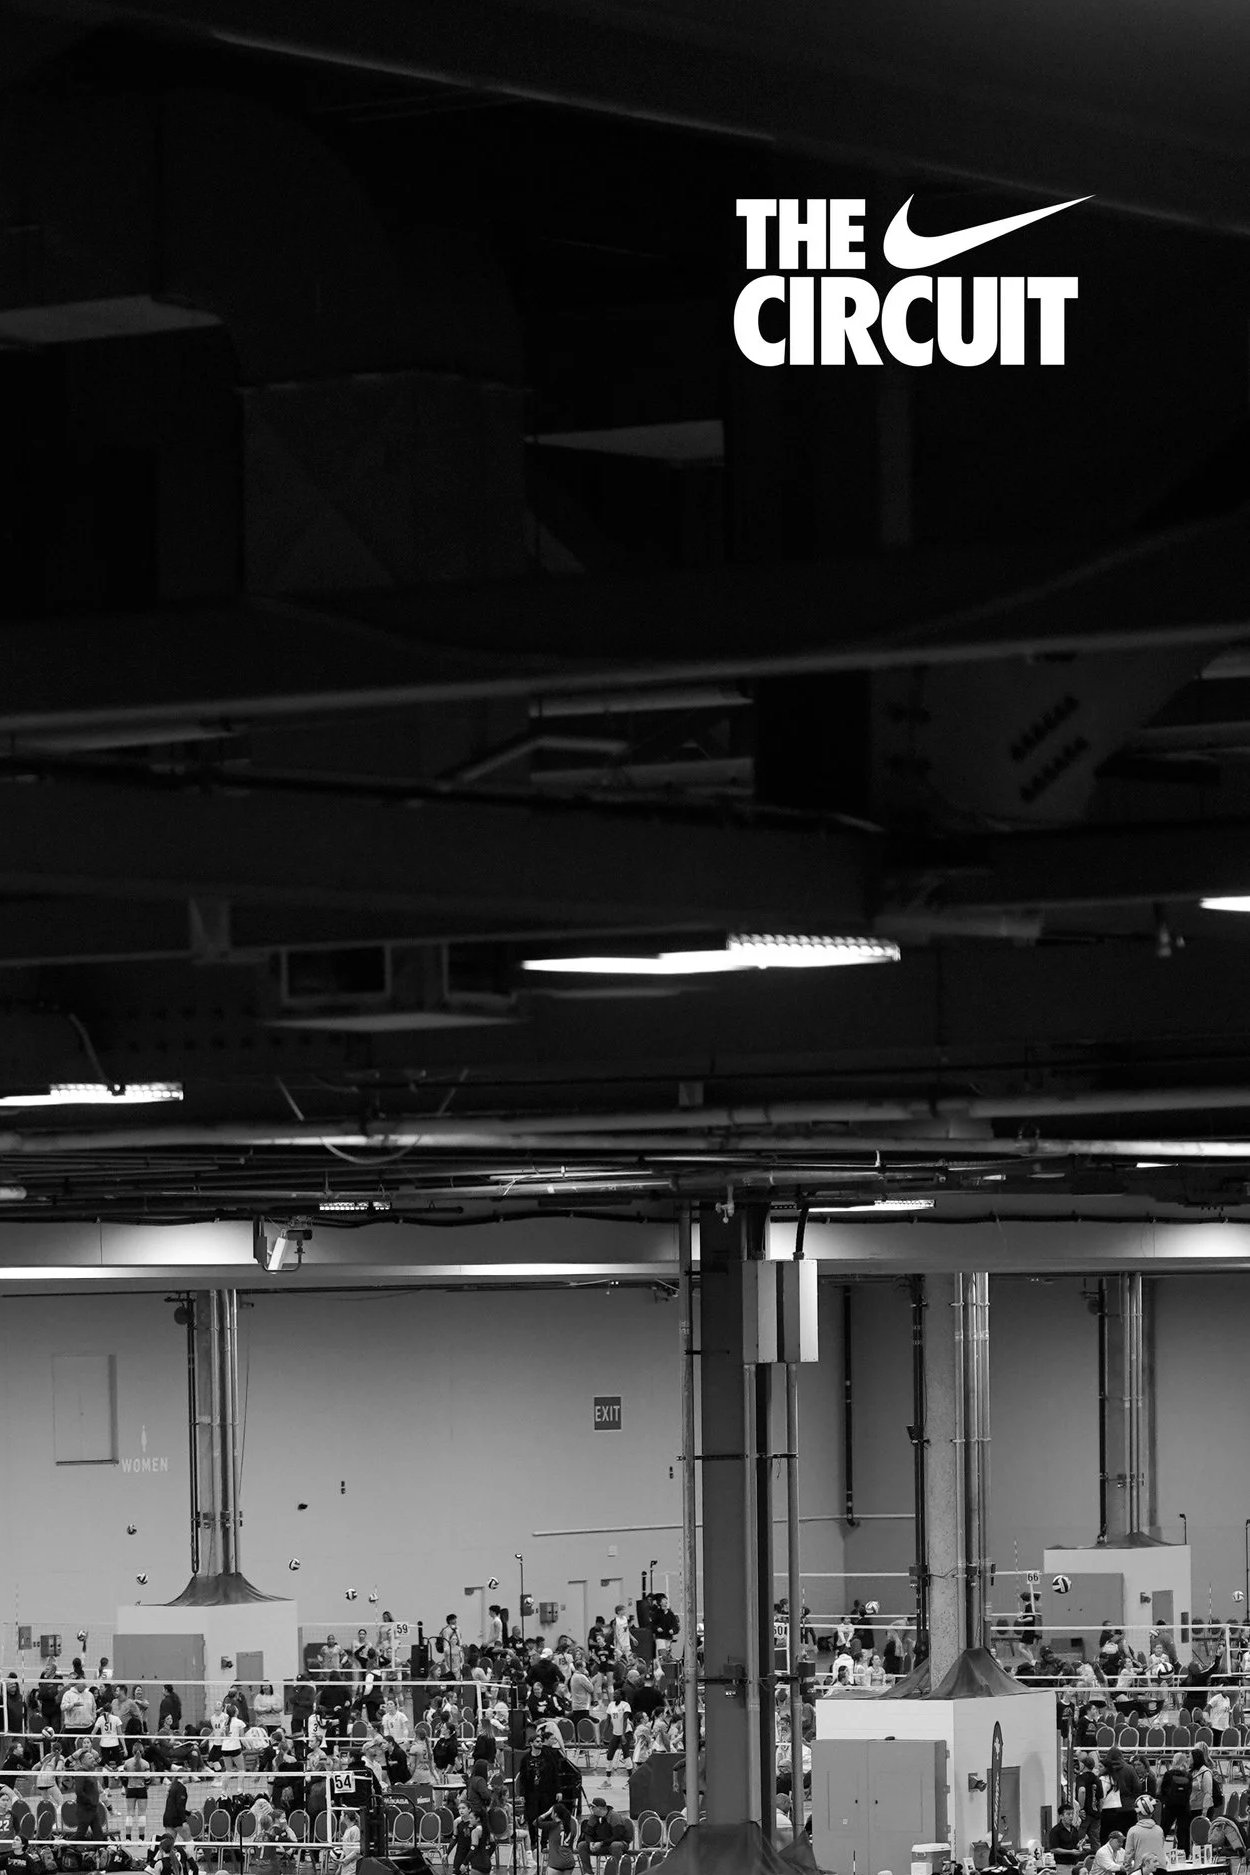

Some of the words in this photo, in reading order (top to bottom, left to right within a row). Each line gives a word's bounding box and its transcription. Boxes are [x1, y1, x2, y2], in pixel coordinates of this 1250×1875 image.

[595, 1405, 620, 1421] EXIT
[121, 1457, 169, 1473] WOMEN
[1027, 1573, 1039, 1582] 66
[396, 1624, 408, 1634] 59
[334, 1775, 352, 1789] 54
